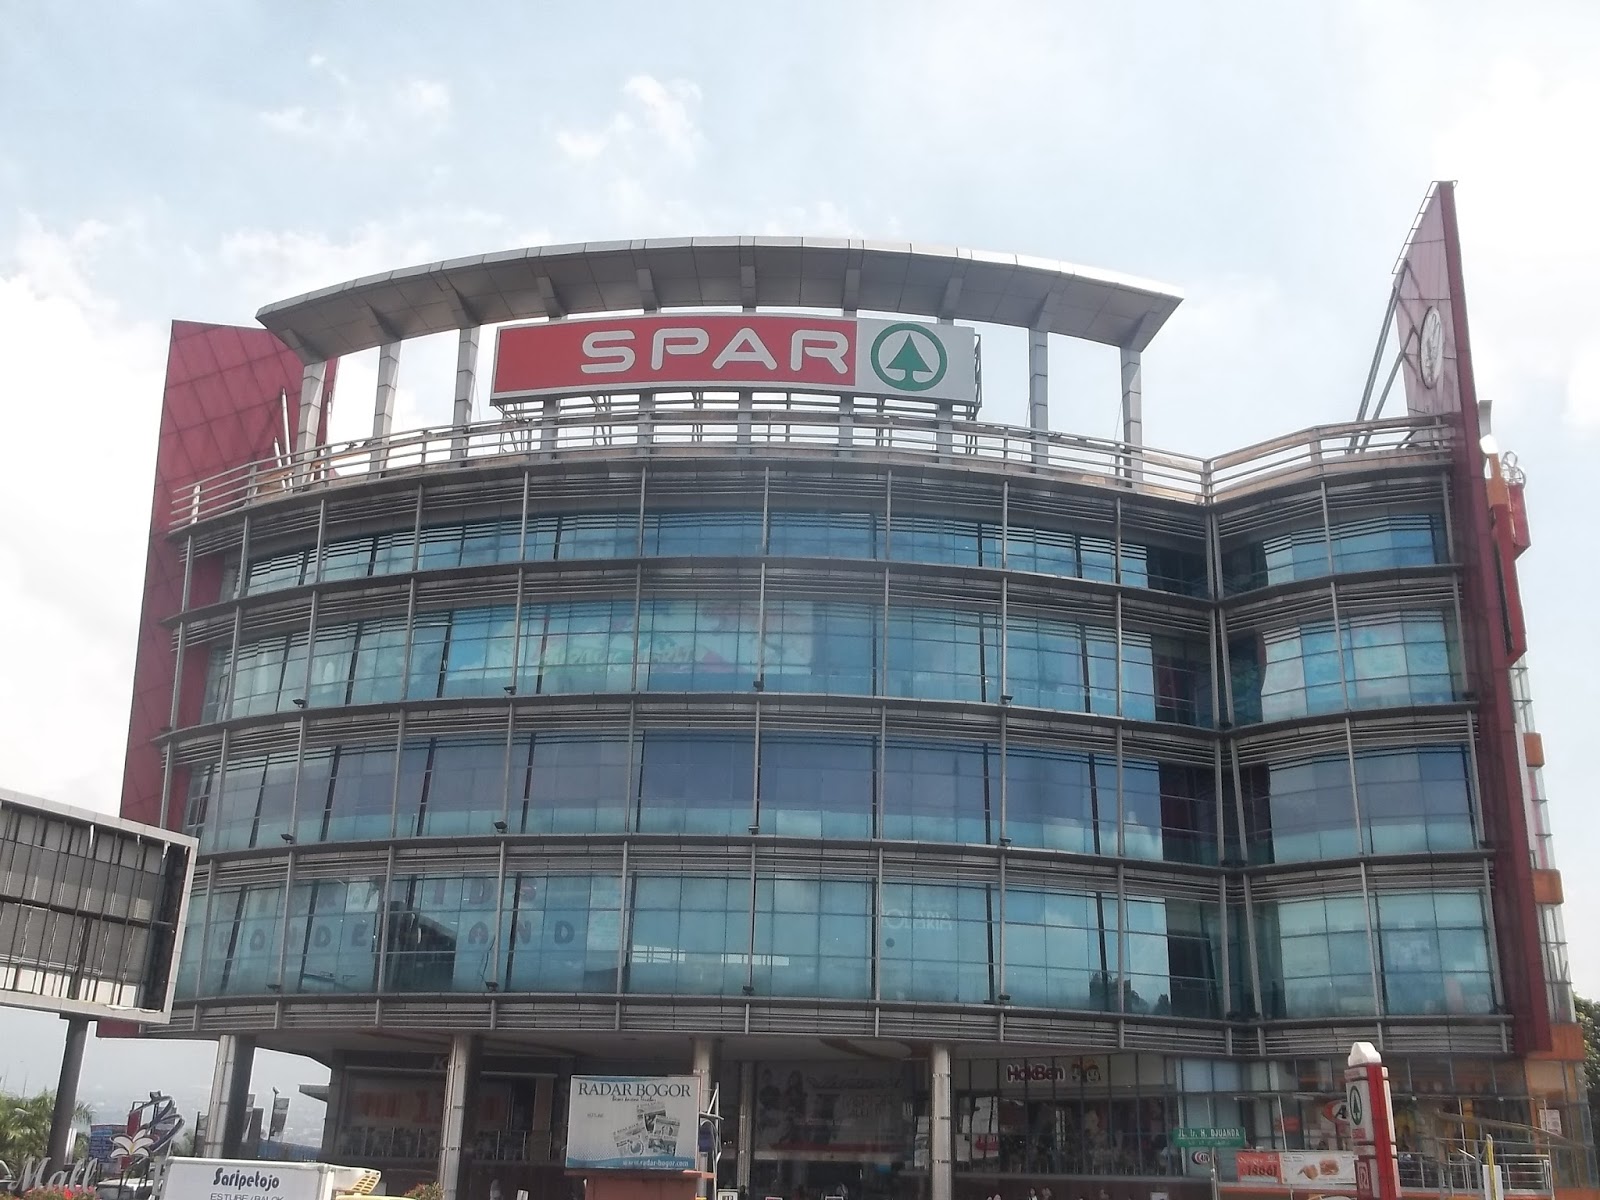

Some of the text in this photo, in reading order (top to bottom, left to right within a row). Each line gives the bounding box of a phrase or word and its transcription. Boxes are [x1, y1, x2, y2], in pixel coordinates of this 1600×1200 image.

[581, 327, 850, 374] SPAR
[881, 909, 952, 930] OLARIA
[1007, 1065, 1065, 1082] HokBen
[578, 1082, 691, 1097] RADAR BOGOR
[1211, 1128, 1240, 1137] DJUANDA
[7, 1156, 98, 1192] Mall
[212, 1166, 280, 1192] Saripetojo
